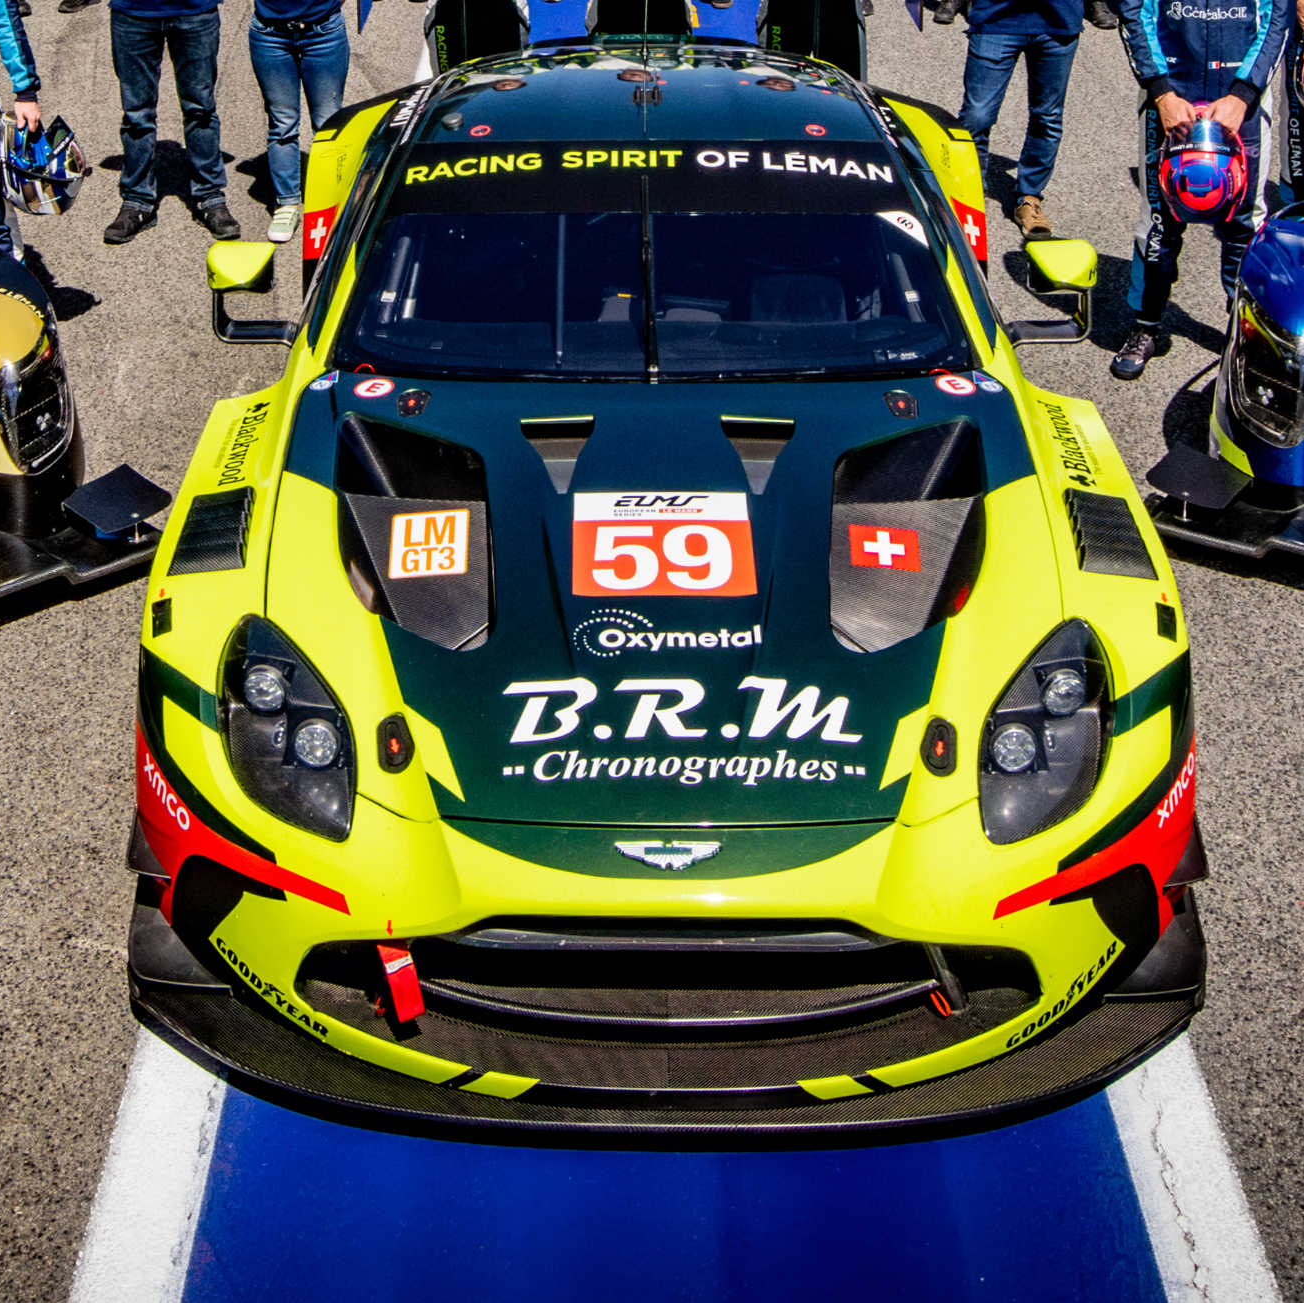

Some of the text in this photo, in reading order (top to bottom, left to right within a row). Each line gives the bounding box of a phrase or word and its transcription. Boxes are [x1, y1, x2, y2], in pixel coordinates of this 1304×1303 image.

[435, 24, 449, 72] RACING
[1145, 108, 1158, 164] RACING
[404, 152, 542, 185] RACING
[562, 149, 683, 169] SPIRIT
[697, 150, 750, 168] OF
[1148, 165, 1163, 218] SPIRIT
[216, 409, 269, 487] Blackwood
[1035, 399, 1092, 475] Blackwood
[400, 543, 457, 573] GT3
[401, 514, 457, 548] LM
[591, 524, 734, 592] 59
[598, 623, 763, 653] Oxymetal
[142, 752, 191, 832] xmco
[532, 748, 839, 787] Chronographes
[1156, 752, 1196, 829] xmco
[215, 937, 330, 1040] GOODYEAR
[1005, 939, 1120, 1050] GOODYEAR
